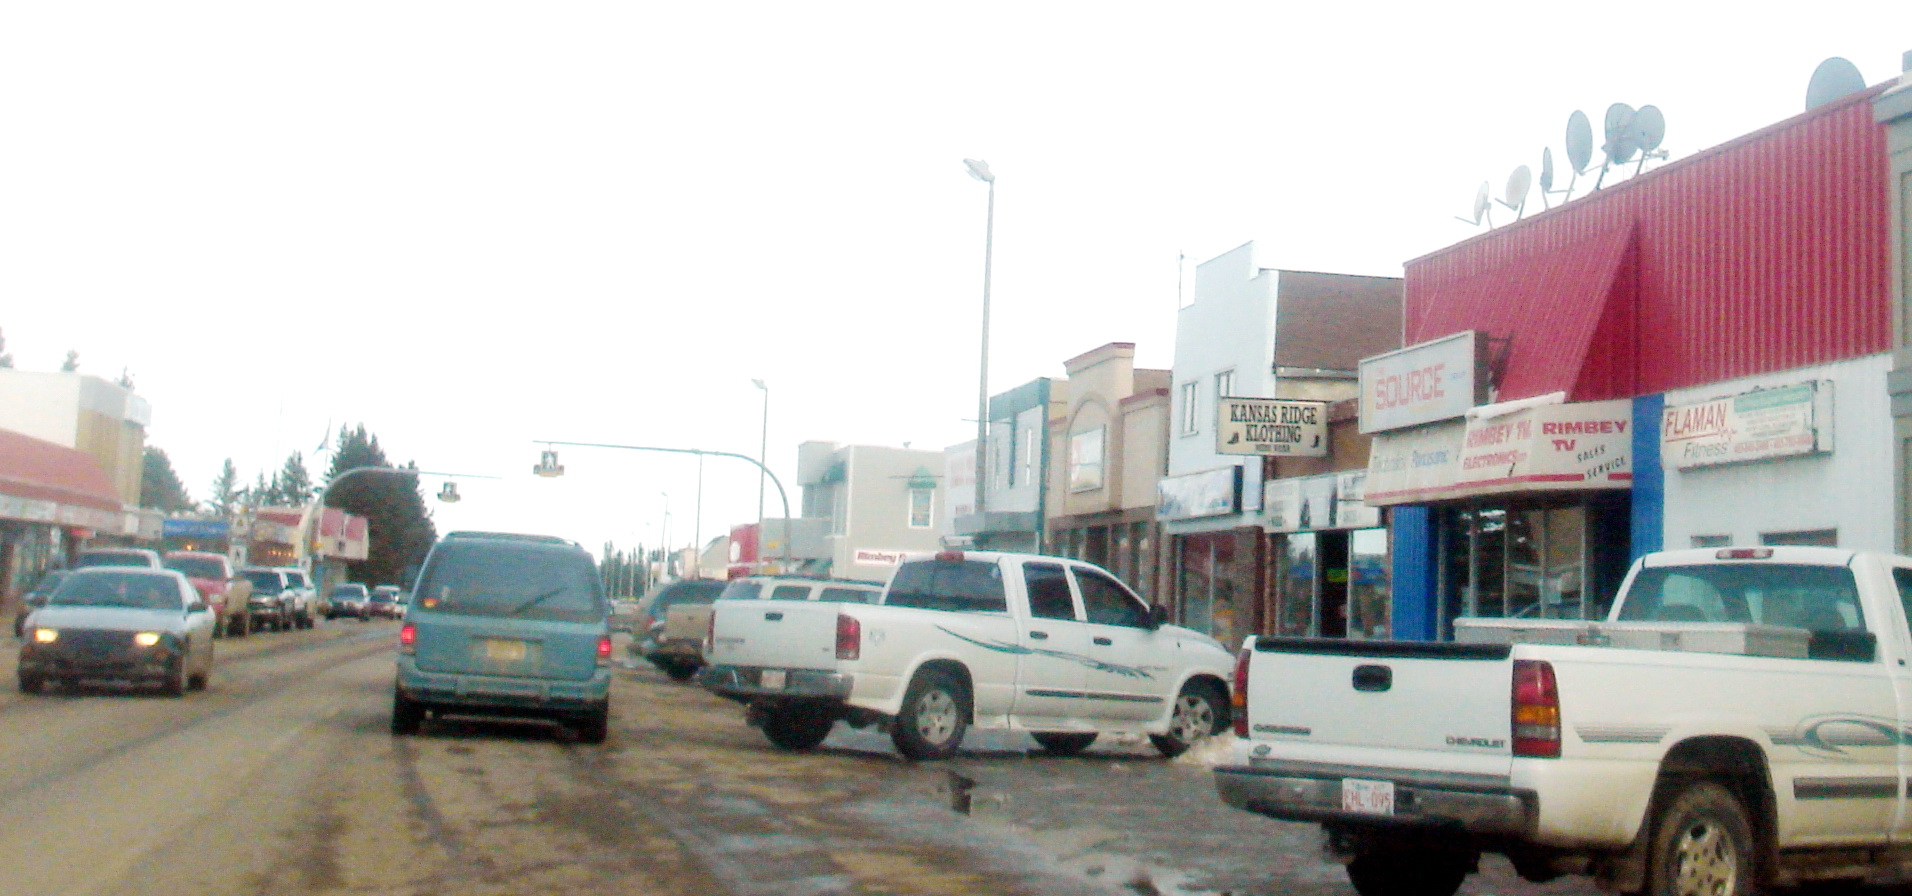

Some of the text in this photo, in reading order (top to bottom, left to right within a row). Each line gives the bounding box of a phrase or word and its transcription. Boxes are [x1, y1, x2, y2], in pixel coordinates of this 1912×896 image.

[1375, 363, 1445, 410] SOURCE
[1230, 404, 1318, 424] KANSAS RIDGE
[1665, 402, 1727, 437] FLAMAN
[1246, 424, 1302, 443] KLOTHING
[1467, 423, 1514, 448] RIMBEY
[1543, 421, 1627, 434] RIMBEY
[1551, 439, 1576, 451] TV
[1577, 444, 1605, 463] SALES
[1683, 441, 1729, 459] Fitness
[1587, 456, 1627, 479] SERVICE
